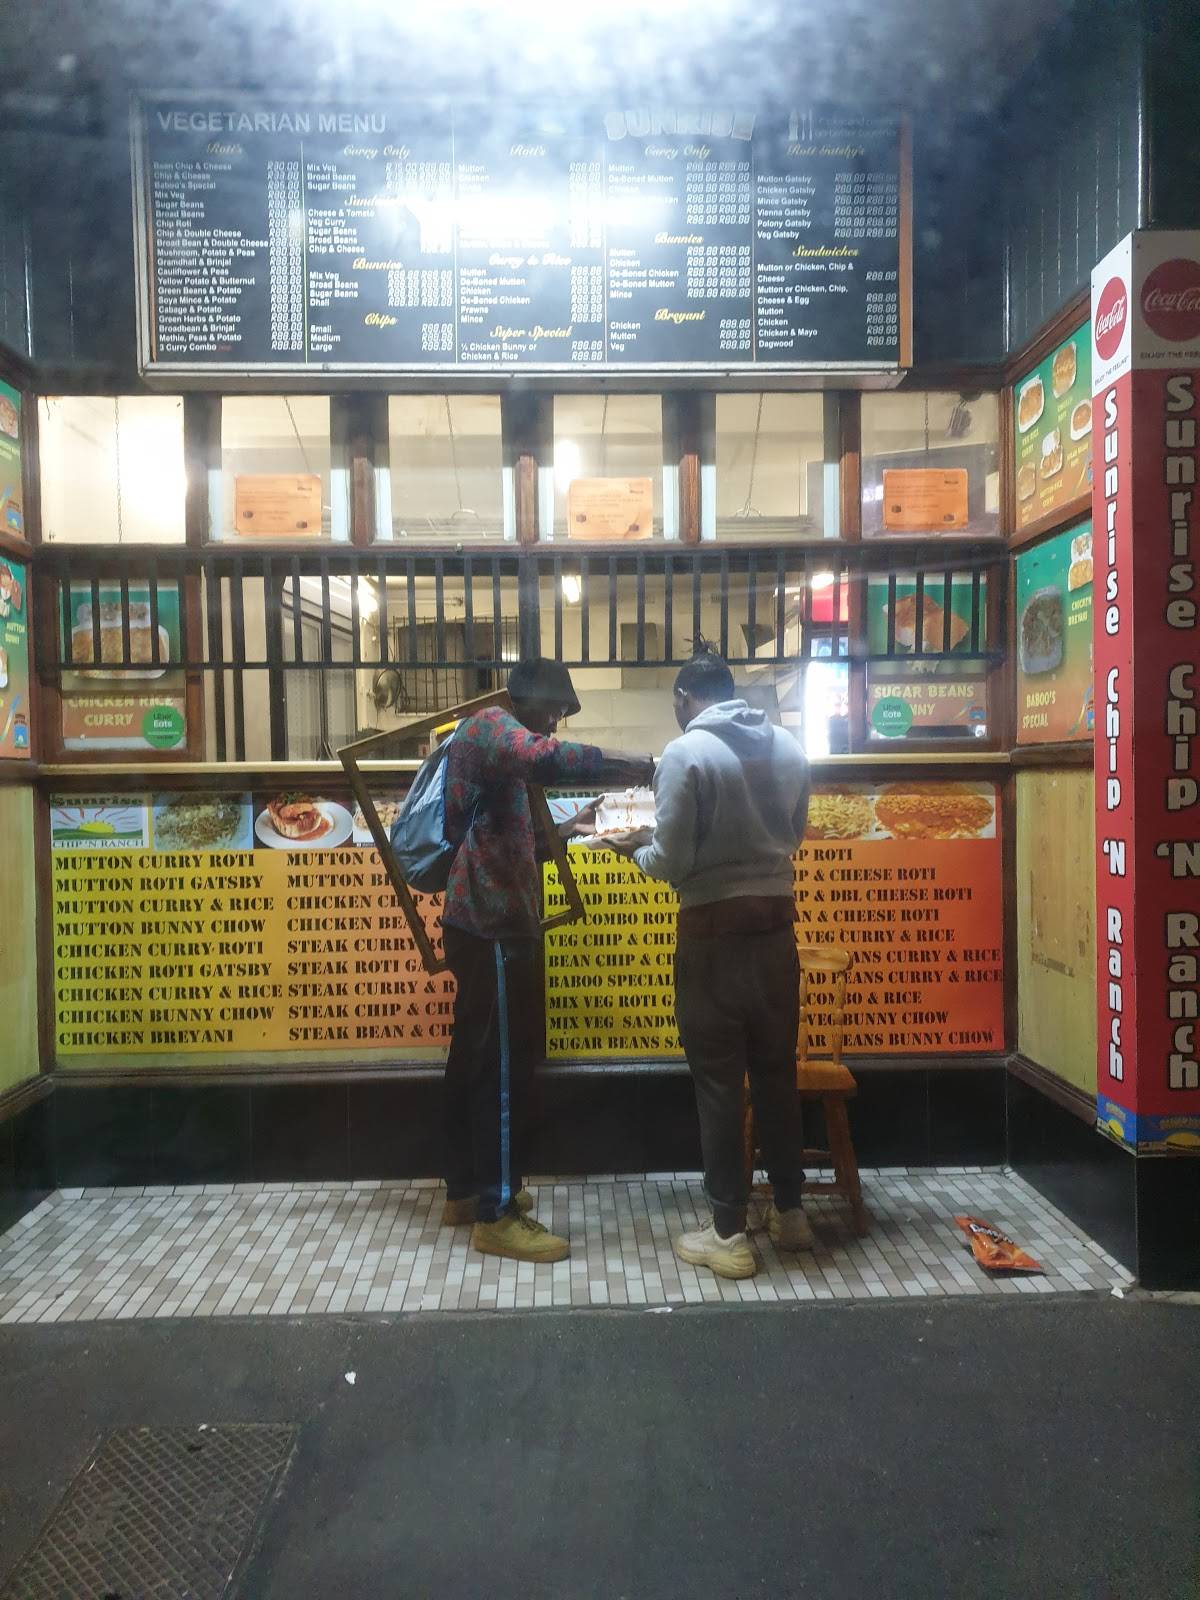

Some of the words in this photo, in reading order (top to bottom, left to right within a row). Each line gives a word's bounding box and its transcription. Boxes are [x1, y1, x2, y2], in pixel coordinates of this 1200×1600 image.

[157, 112, 311, 132] VEGETARIAN
[318, 112, 386, 133] MENU
[1165, 375, 1196, 628] Sunrise
[1104, 387, 1120, 635] Sunrise
[874, 686, 922, 698] SUGAR
[928, 686, 975, 698] BEANS
[84, 714, 133, 726] CURRY
[1023, 712, 1048, 729] SPECIAL
[1106, 667, 1121, 810] Chip
[1167, 664, 1198, 810] Chip
[56, 857, 133, 870] MUTTON
[139, 855, 203, 869] CURRY
[210, 854, 254, 868] ROTI
[287, 853, 363, 866] MUTTON
[582, 852, 611, 865] VEG
[814, 848, 852, 861] ROTI
[287, 875, 364, 888] MUTTON
[606, 872, 646, 884] BEAN
[830, 868, 892, 881] CHEESE
[898, 868, 936, 880] ROTI
[56, 878, 133, 892] MUTTON
[140, 877, 184, 891] ROTI
[191, 875, 263, 889] GATSBY
[547, 893, 602, 906] BRAD
[607, 893, 649, 905] BEAN
[831, 890, 862, 902] DBL
[867, 889, 928, 901] CHEESE
[934, 888, 972, 900] ROTI
[57, 900, 133, 914] MUTTON
[140, 898, 204, 913] CURRY
[230, 897, 274, 910] RICE
[287, 896, 371, 910] CHICKEN
[583, 912, 638, 926] COMBO
[833, 910, 896, 922] CHEESE
[901, 909, 939, 921] ROTI
[57, 922, 134, 936] MUTTON
[141, 920, 204, 935] BUNNY
[211, 919, 266, 933] CHOW
[287, 917, 372, 932] CHICKEN
[549, 934, 578, 947] VEG
[583, 933, 622, 947] CHIP
[805, 930, 835, 944] VEG
[840, 930, 895, 943] CURRY
[917, 929, 955, 942] RICE
[57, 944, 142, 958] CHICKEN
[148, 942, 213, 957] CURRY
[219, 941, 263, 954] ROTI
[288, 940, 348, 954] STEAK
[354, 938, 417, 952] CURRY
[549, 954, 590, 967] BEAN
[595, 954, 635, 966] CHIP
[887, 950, 941, 963] CURRY
[963, 949, 1000, 961] RICE
[58, 966, 143, 980] CHICKEN
[150, 964, 194, 979] ROTI
[200, 963, 272, 977] GATSBY
[288, 962, 348, 976] STEAK
[355, 961, 399, 974] ROTI
[550, 975, 602, 988] BABOO
[608, 974, 674, 987] SPECIAL
[889, 971, 943, 983] CURRY
[965, 970, 1002, 982] RICE
[58, 988, 143, 1002] CHICKEN
[149, 986, 213, 1000] CURRY
[239, 985, 282, 998] RICE
[288, 983, 348, 997] STEAK
[355, 982, 418, 995] CURRY
[1107, 907, 1123, 1081] Ranch
[550, 996, 579, 1009] MIX
[584, 996, 613, 1008] VEG
[619, 995, 656, 1007] ROTI
[884, 991, 921, 1004] RICE
[1166, 912, 1200, 1089] Ranch
[59, 1010, 143, 1024] CHICKEN
[150, 1008, 214, 1022] BUNNY
[220, 1007, 274, 1020] CHOW
[289, 1005, 349, 1019] STEAK
[355, 1004, 401, 1018] CHIP
[843, 1012, 896, 1025] BUNNY
[902, 1011, 949, 1024] CHOW
[550, 1016, 579, 1029] MIX
[584, 1016, 614, 1029] VEG
[59, 1031, 144, 1046] CHICKEN
[151, 1029, 233, 1044] BREYANI
[289, 1027, 349, 1041] STEAK
[356, 1025, 404, 1039] BEAN
[836, 1033, 883, 1047] EANS
[889, 1032, 943, 1046] BUNNY
[949, 1031, 993, 1044] CHOW
[550, 1036, 602, 1050] SUGAR
[608, 1036, 659, 1049] BEANS
